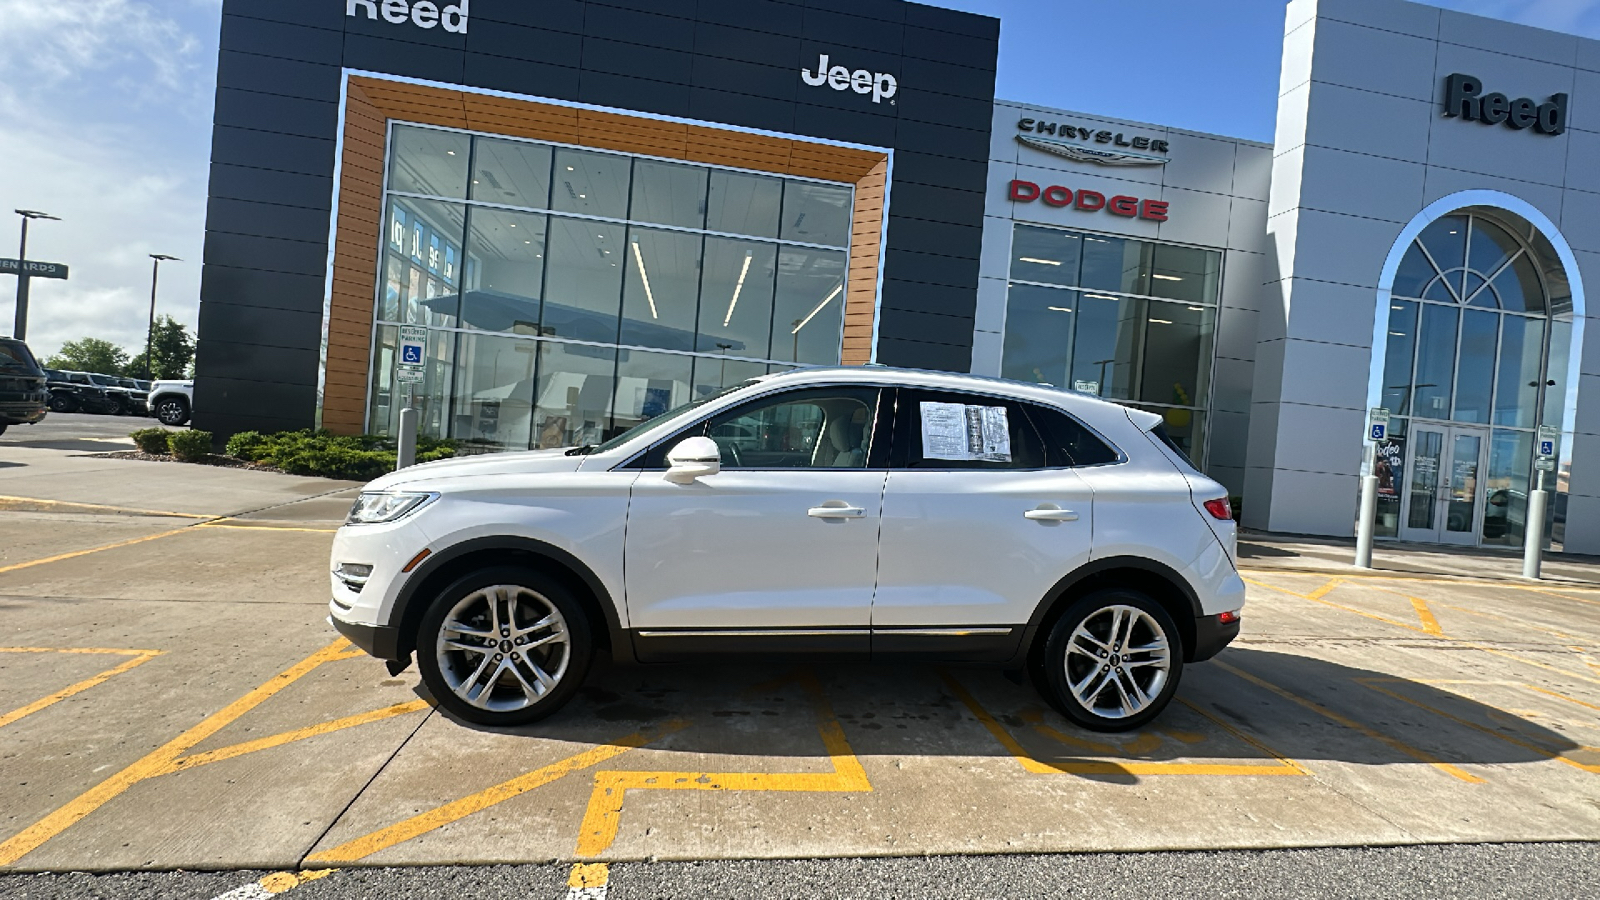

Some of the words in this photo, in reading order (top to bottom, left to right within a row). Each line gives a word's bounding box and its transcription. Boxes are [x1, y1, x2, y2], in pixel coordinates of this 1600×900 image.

[346, 0, 469, 34] Reed
[801, 54, 897, 104] Jeep
[1444, 73, 1568, 135] Reed
[1018, 118, 1169, 152] CHRYSLER
[1009, 179, 1169, 221] DODGE
[0, 261, 56, 273] ENRDS
